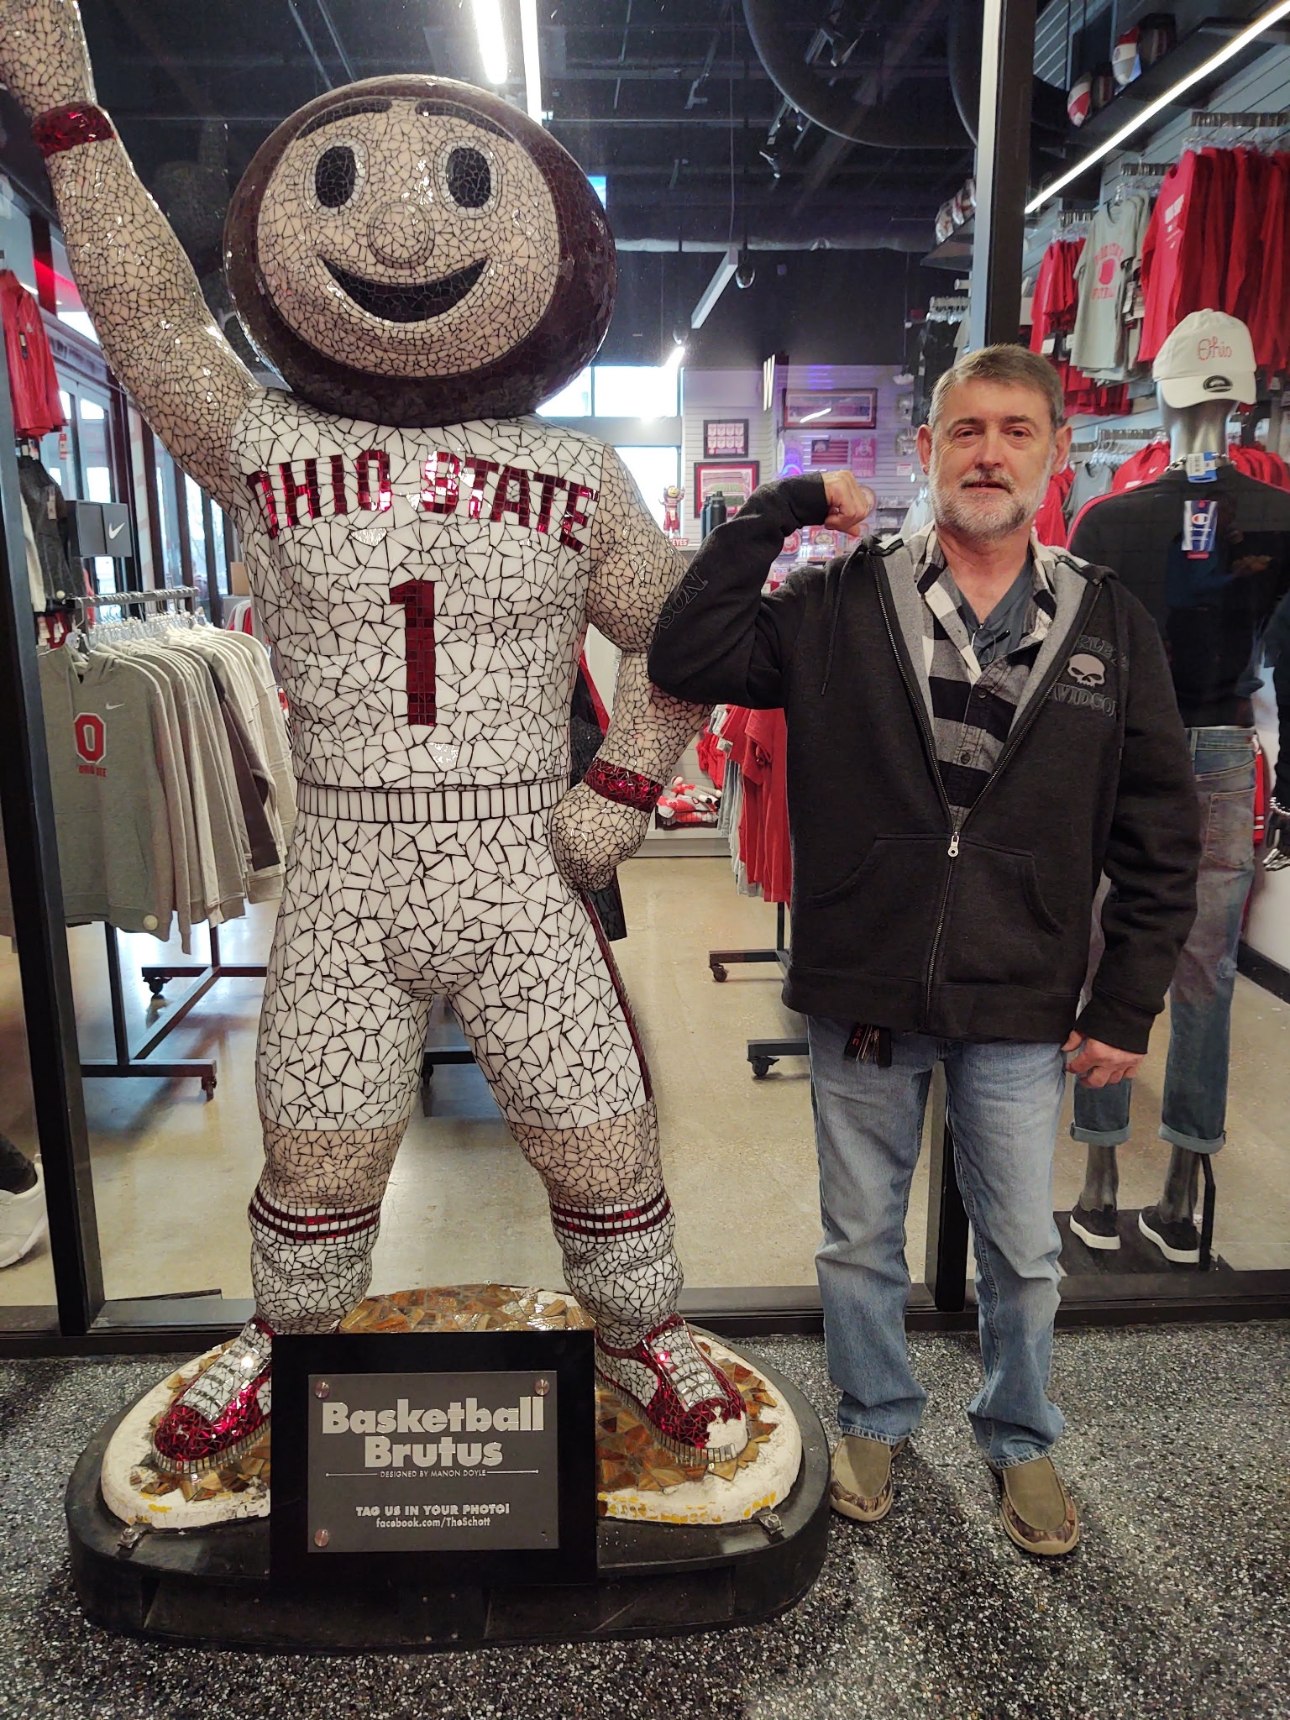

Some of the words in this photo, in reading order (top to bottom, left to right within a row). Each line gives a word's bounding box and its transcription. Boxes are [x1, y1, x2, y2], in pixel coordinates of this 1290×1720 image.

[247, 450, 391, 540] OHIO
[420, 450, 599, 550] STATE
[390, 580, 436, 726] 1
[322, 1396, 544, 1434] Basketball
[364, 1436, 503, 1468] Brutus
[380, 1470, 417, 1478] DESIGNED
[419, 1470, 429, 1478] BY
[430, 1469, 461, 1477] MANON
[463, 1469, 487, 1477] DOYLE
[356, 1506, 381, 1517] TAG
[384, 1505, 401, 1516] US
[404, 1505, 419, 1516] IN
[423, 1504, 459, 1516] YOUR
[462, 1503, 510, 1515] PHOTO!
[376, 1516, 491, 1529] facebook.com/TheSchott
